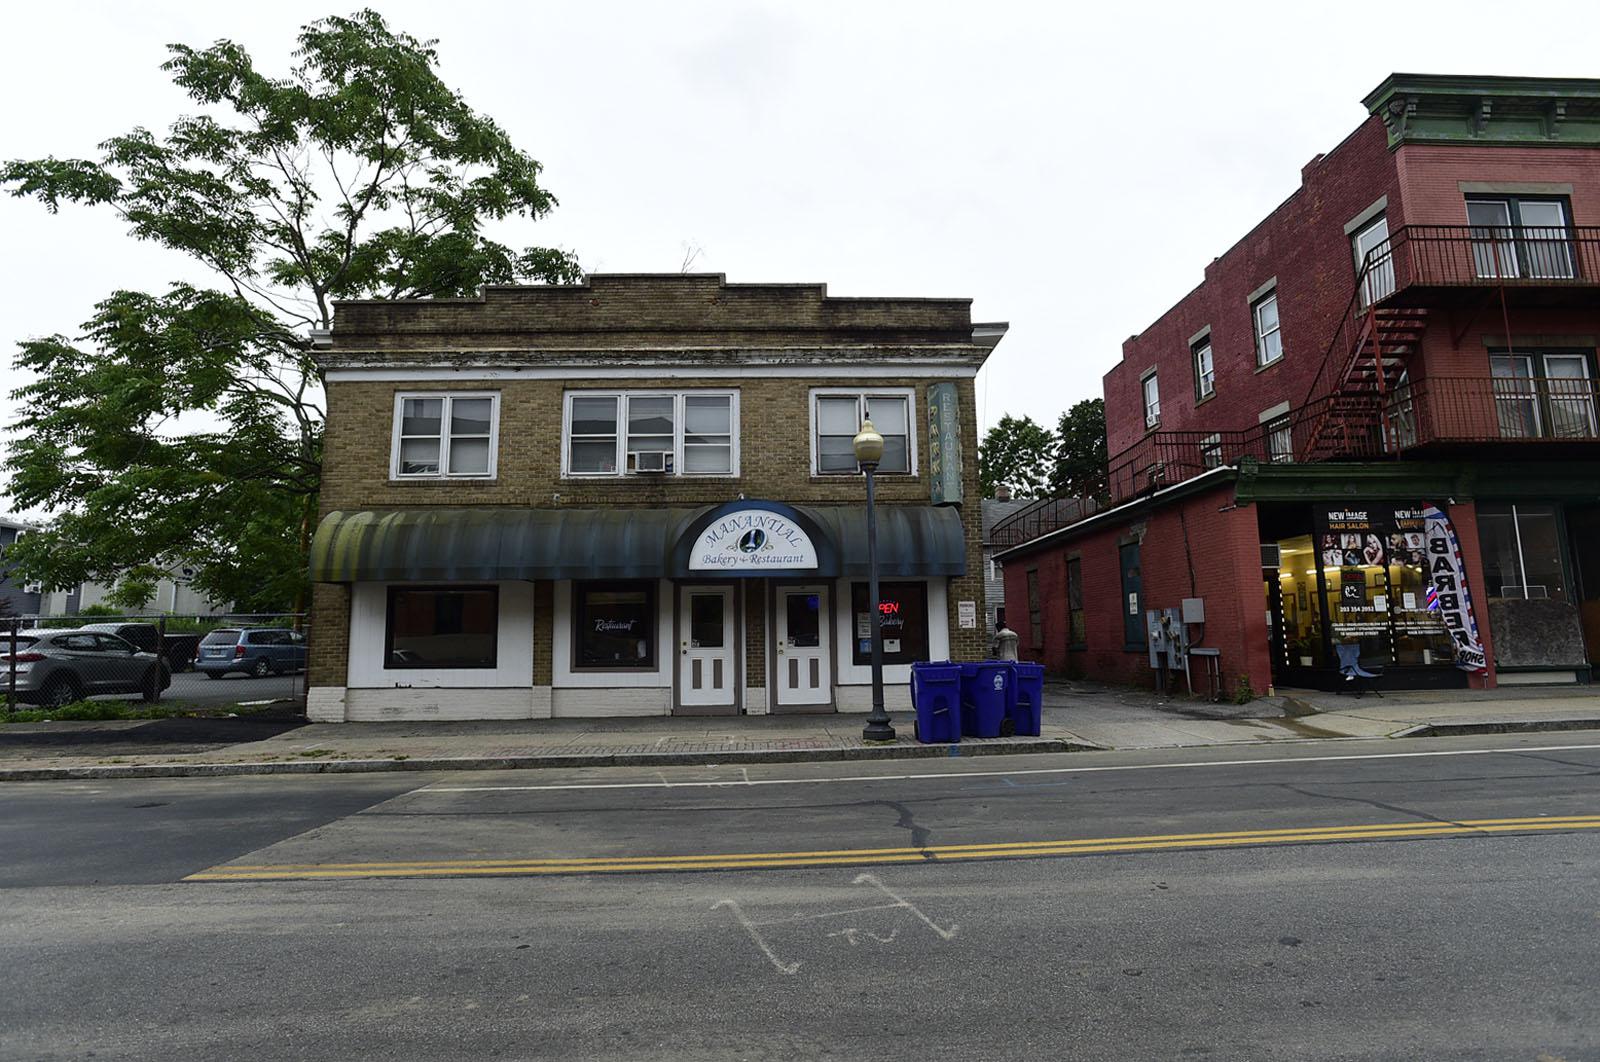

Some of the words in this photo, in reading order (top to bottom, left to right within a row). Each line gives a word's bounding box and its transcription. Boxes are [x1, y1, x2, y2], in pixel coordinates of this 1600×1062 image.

[1328, 511, 1345, 520] NEW
[1345, 508, 1369, 520] IMAGE
[1394, 510, 1411, 519] NEW
[705, 515, 803, 548] MANANTIAL
[703, 552, 739, 567] Bakery
[749, 553, 804, 564] Restaurant
[879, 601, 900, 615] PEN
[593, 618, 638, 632] Restaurant
[879, 615, 905, 630] Bakery
